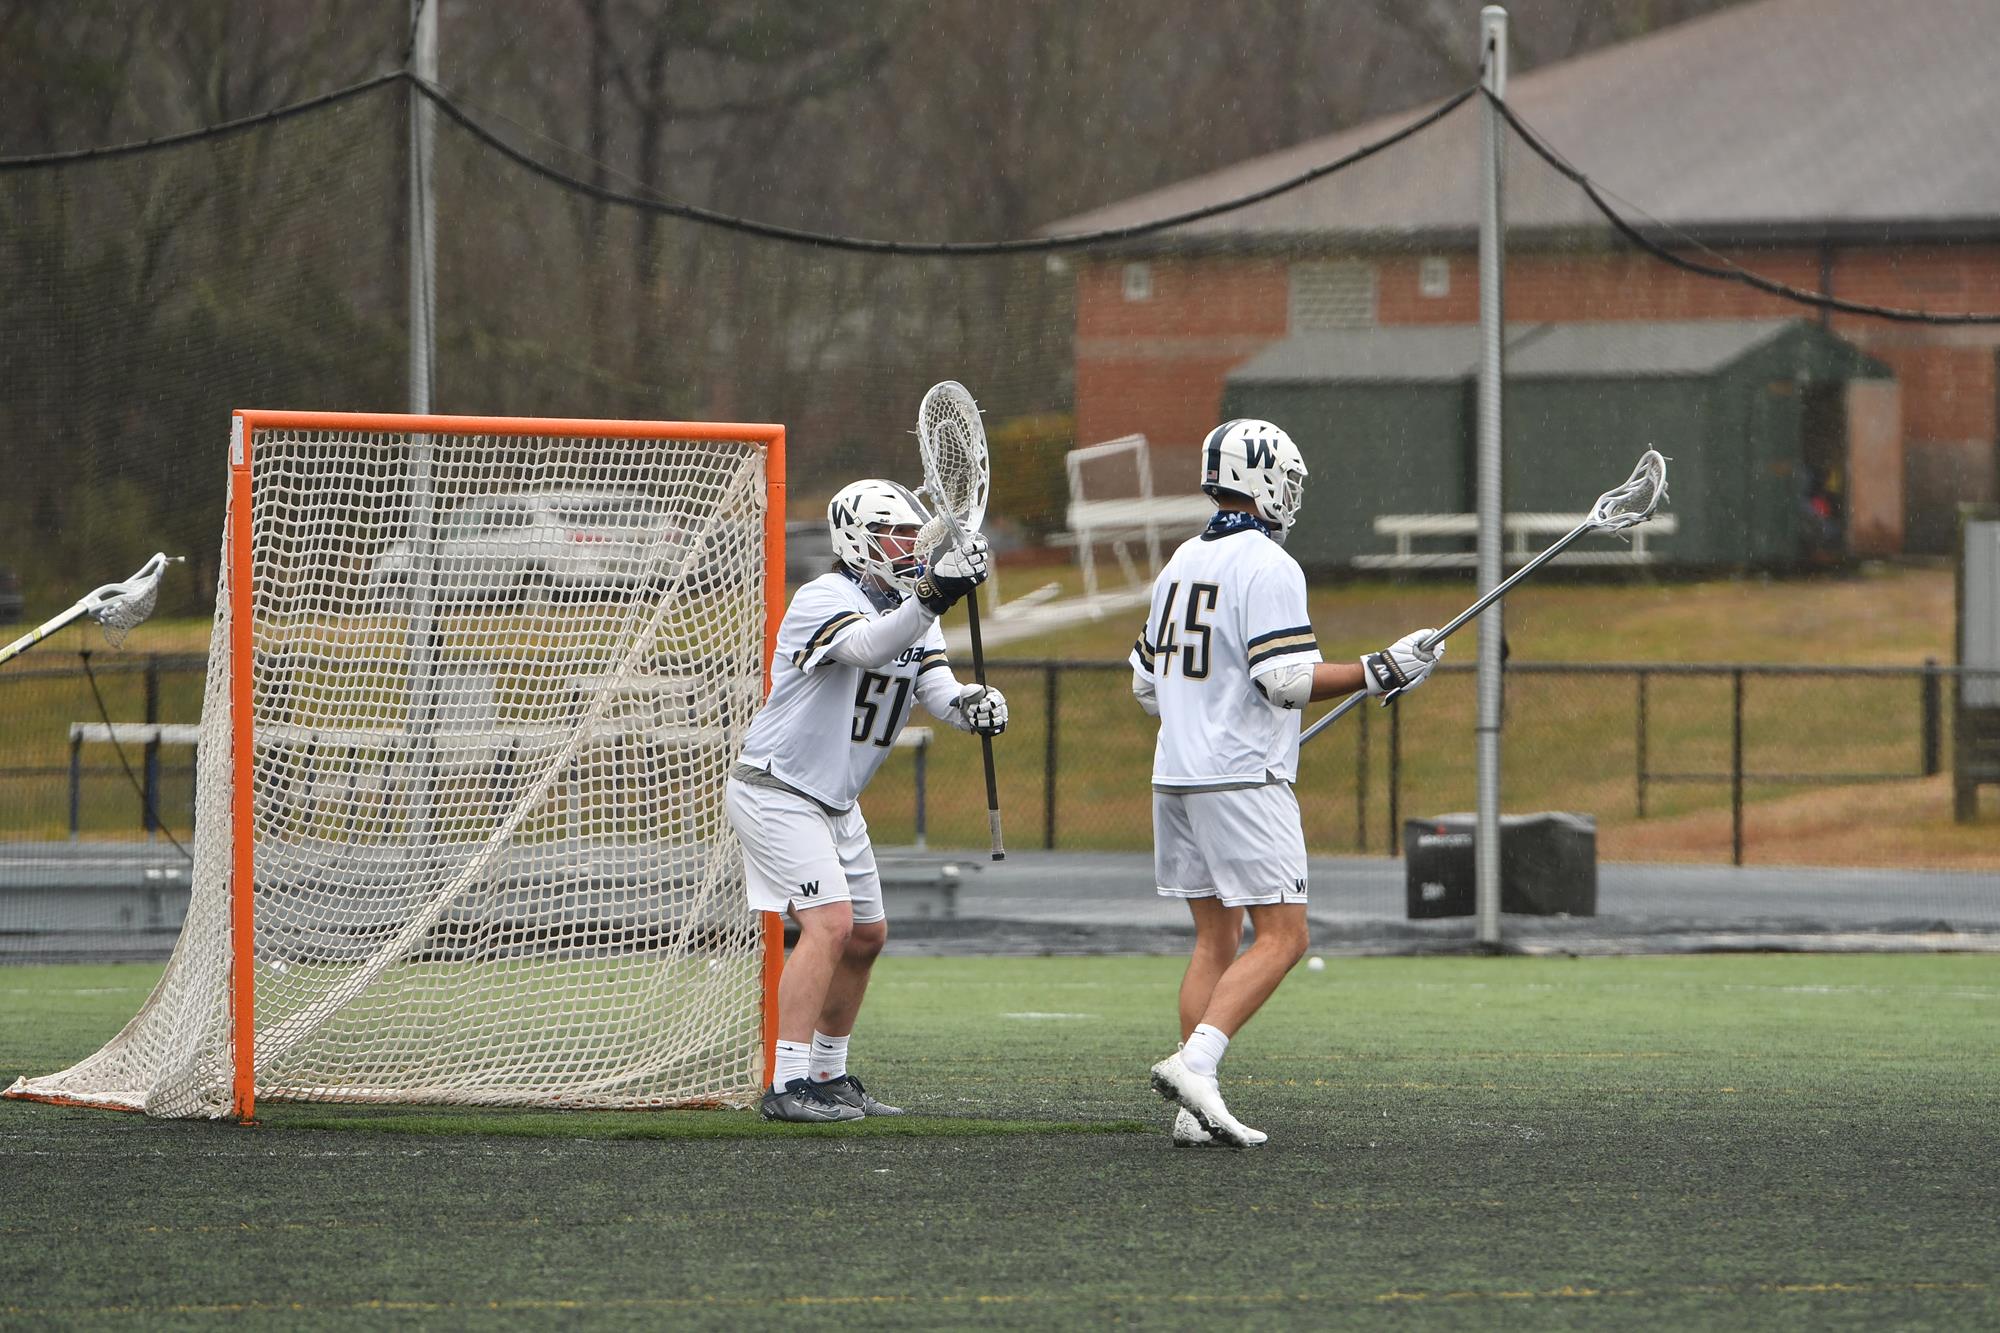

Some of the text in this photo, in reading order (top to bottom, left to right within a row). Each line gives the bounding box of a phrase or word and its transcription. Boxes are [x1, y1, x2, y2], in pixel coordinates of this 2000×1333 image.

[1240, 438, 1279, 469] W
[831, 494, 863, 530] W
[1154, 580, 1219, 680] 45
[851, 670, 911, 747] 51
[799, 880, 820, 897] W
